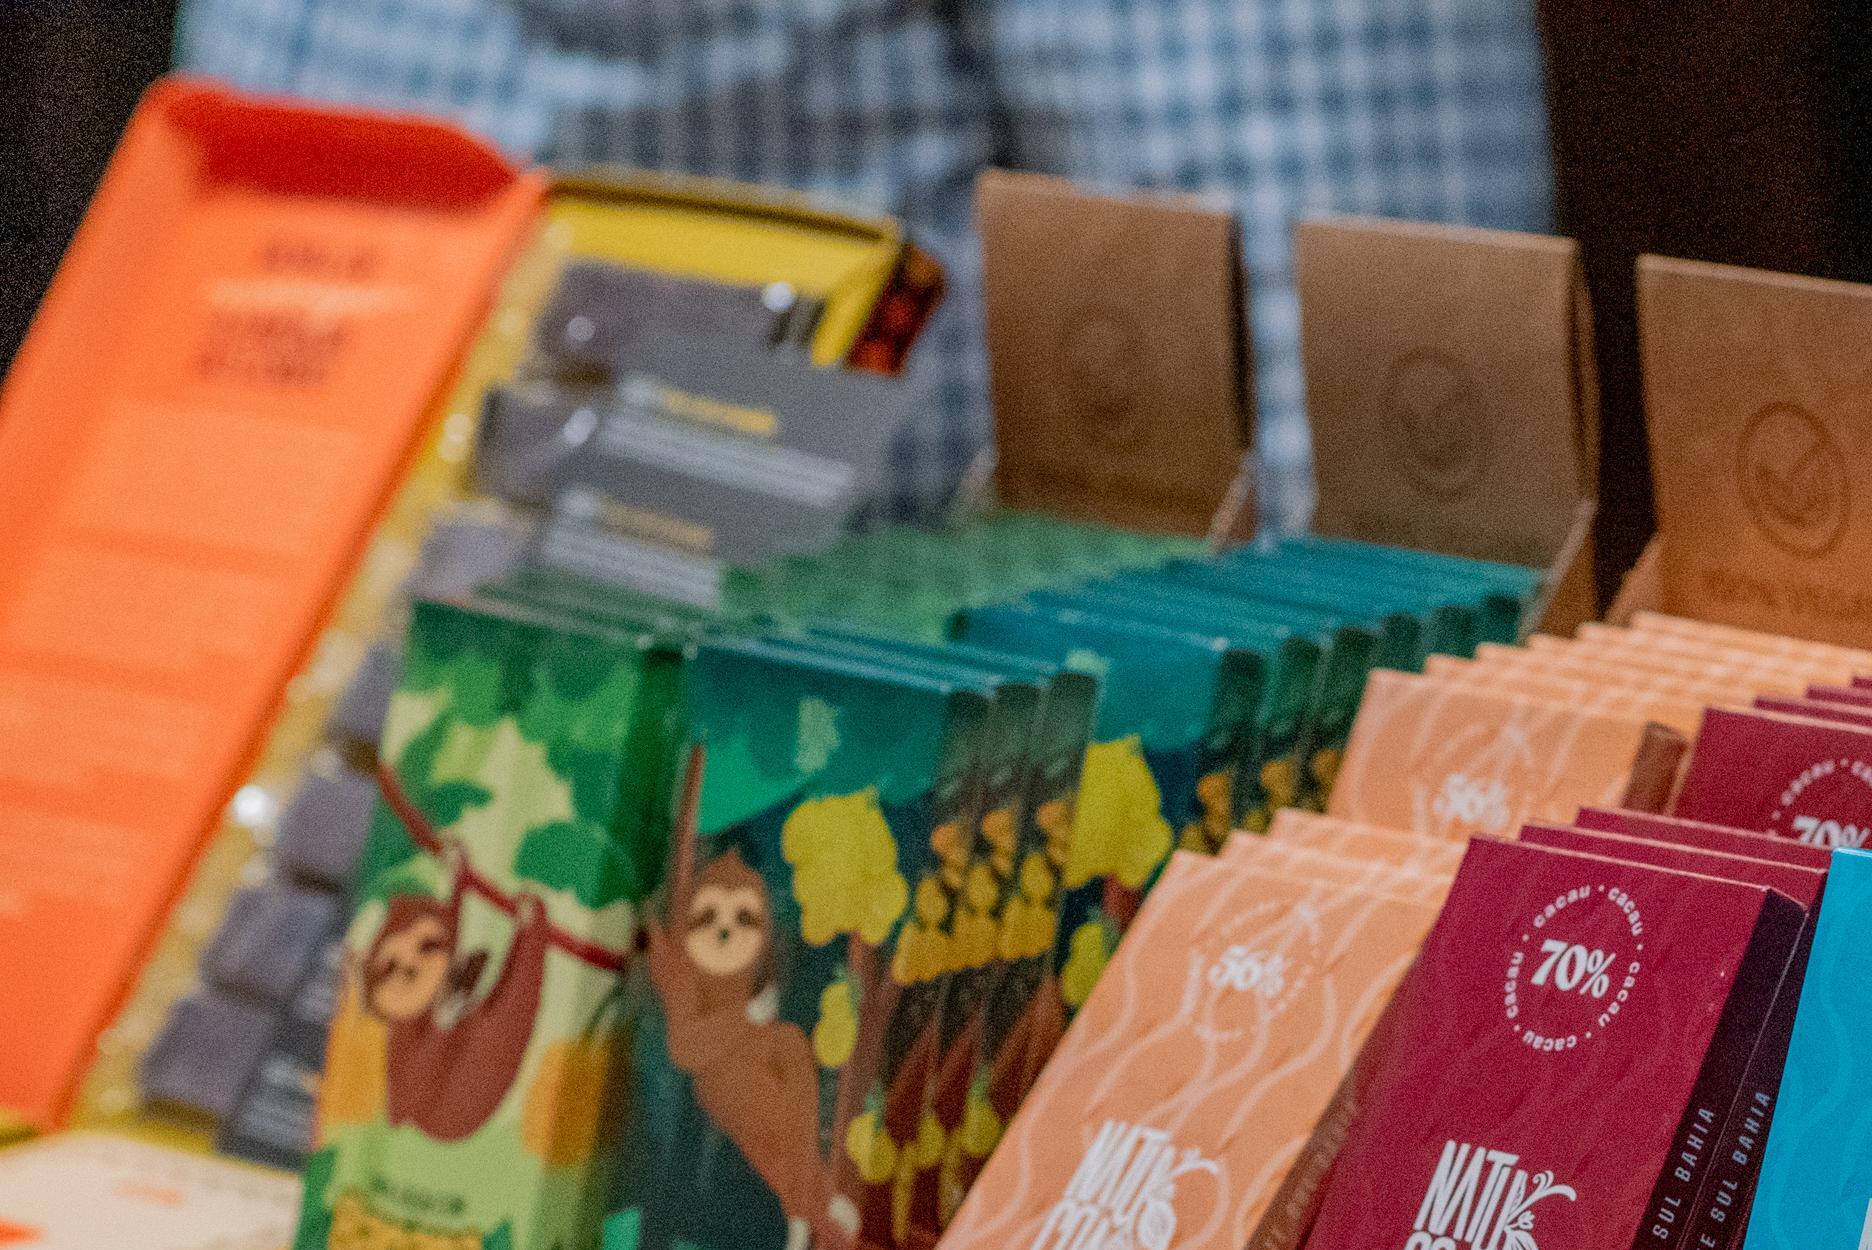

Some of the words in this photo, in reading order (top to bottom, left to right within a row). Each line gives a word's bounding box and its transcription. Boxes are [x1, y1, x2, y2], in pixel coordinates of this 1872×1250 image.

[1531, 938, 1617, 999] 70%
[1652, 1195, 1683, 1240] SUL
[1674, 1106, 1716, 1183] BAHIA
[1710, 1178, 1740, 1224] SUL
[1731, 1090, 1772, 1166] BAHIA
